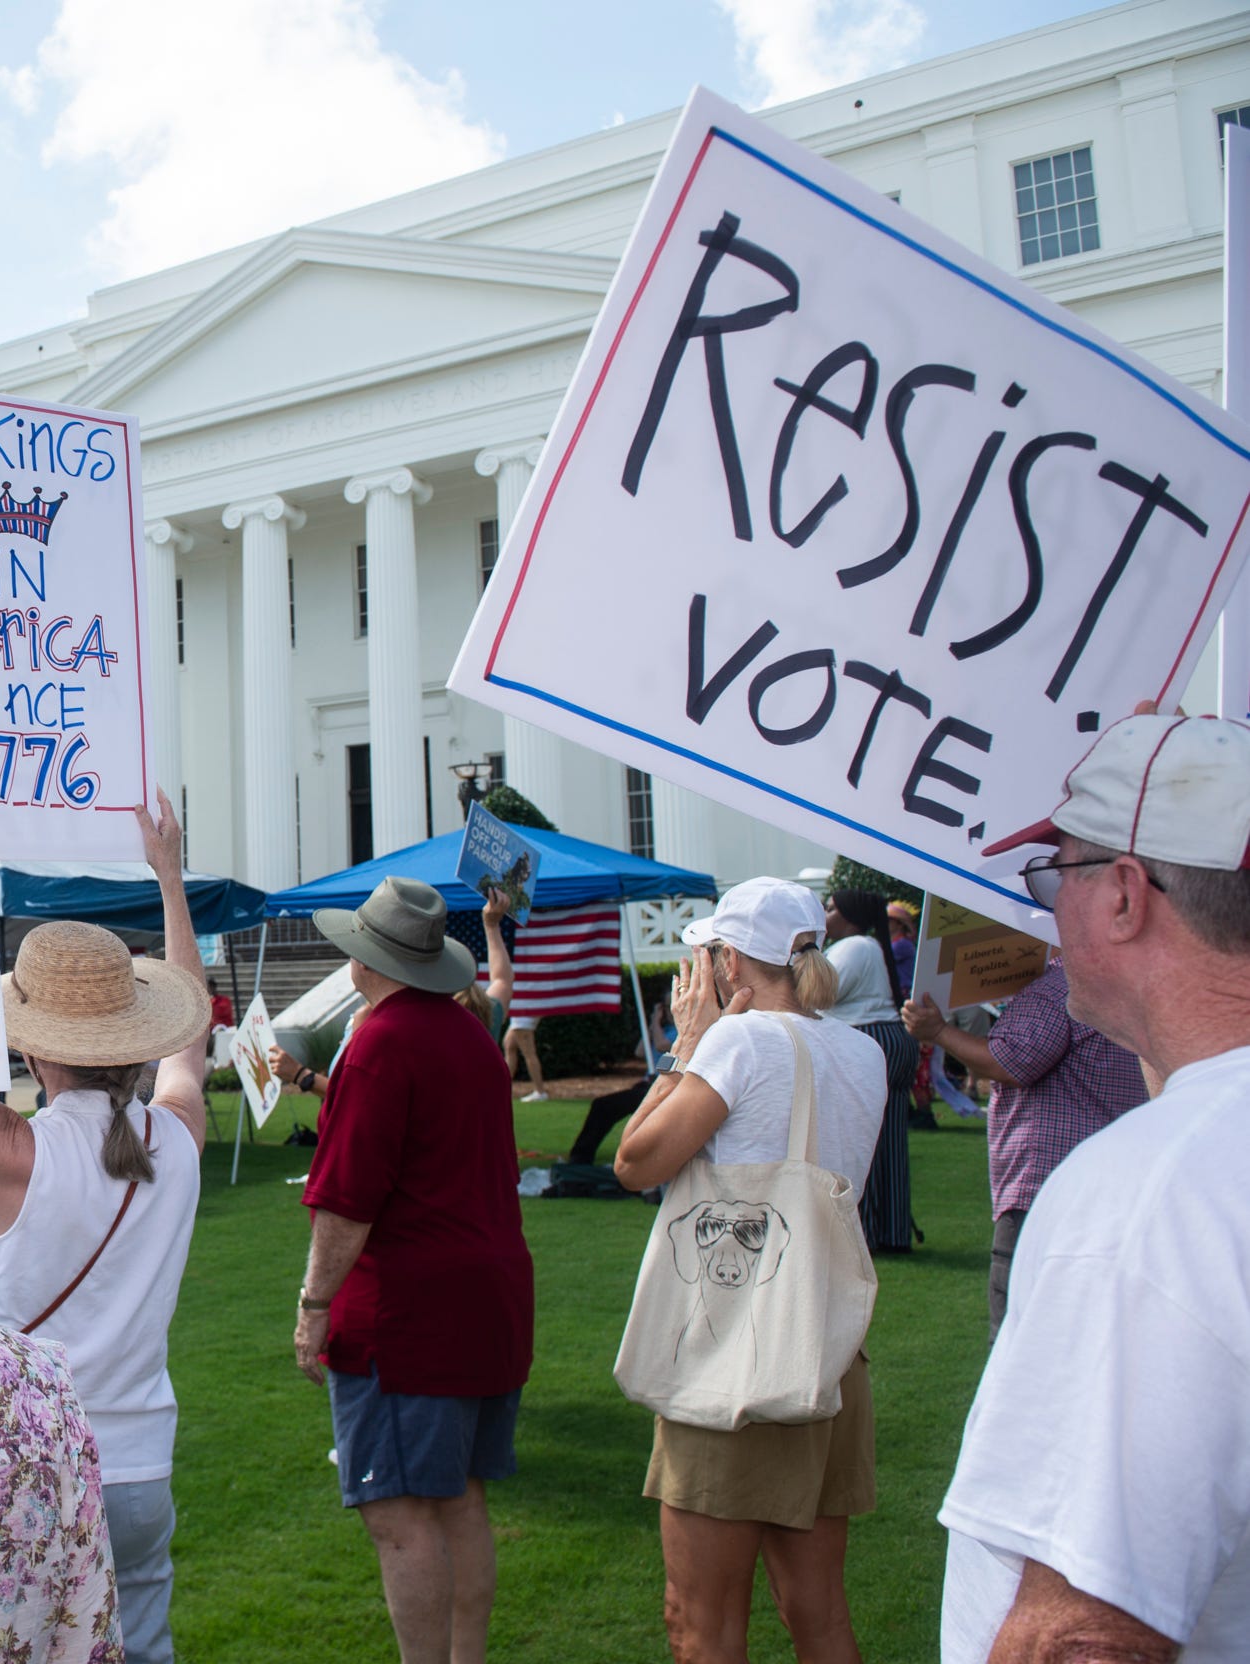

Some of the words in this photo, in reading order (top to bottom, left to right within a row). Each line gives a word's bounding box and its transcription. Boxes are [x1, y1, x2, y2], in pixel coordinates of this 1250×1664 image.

[265, 422, 295, 446] OF
[308, 385, 437, 438] ARCHIVES
[452, 371, 508, 404] AND
[685, 593, 992, 844] VOTE.
[470, 825, 491, 848] OFF
[490, 841, 512, 866] OUR
[474, 813, 507, 845] HANDS
[467, 841, 502, 873] PARKS!
